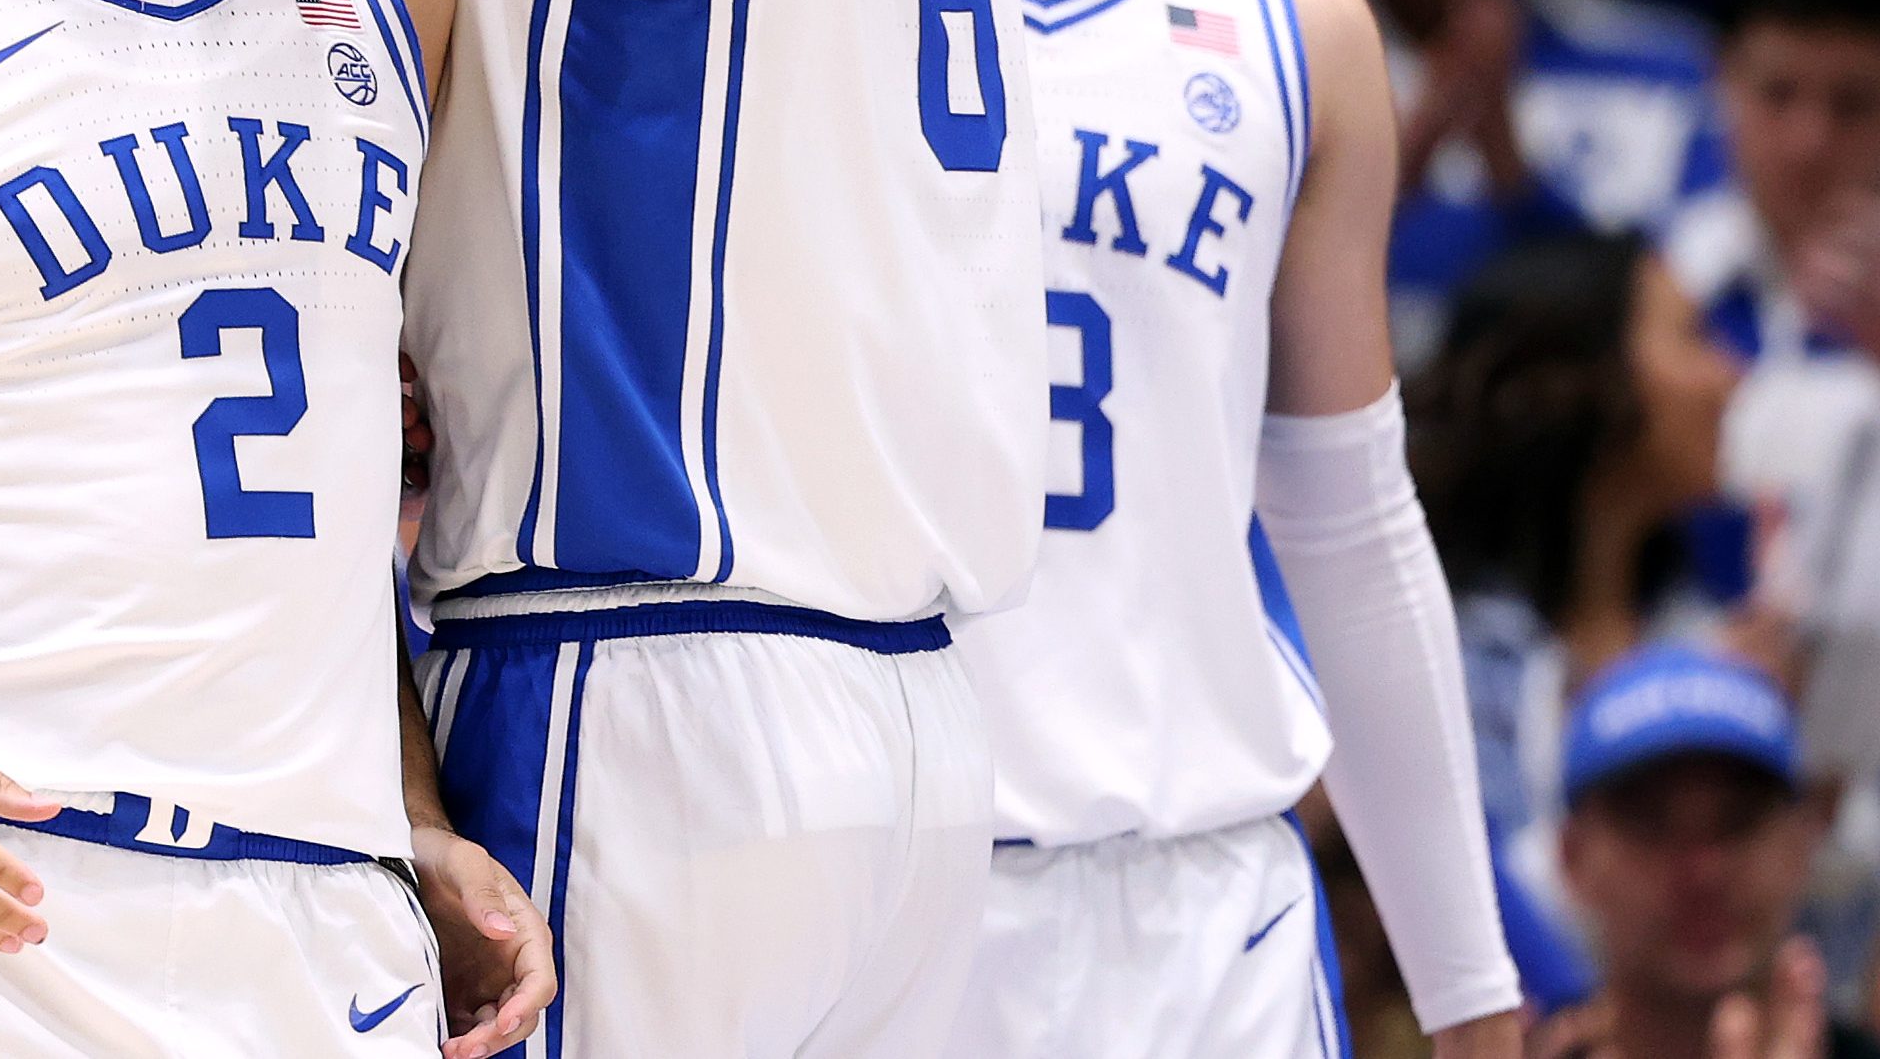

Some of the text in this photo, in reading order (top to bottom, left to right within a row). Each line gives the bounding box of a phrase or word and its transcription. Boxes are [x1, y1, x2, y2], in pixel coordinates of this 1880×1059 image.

[337, 63, 371, 78] ACC
[1061, 128, 1254, 298] KE
[178, 287, 316, 540] 2
